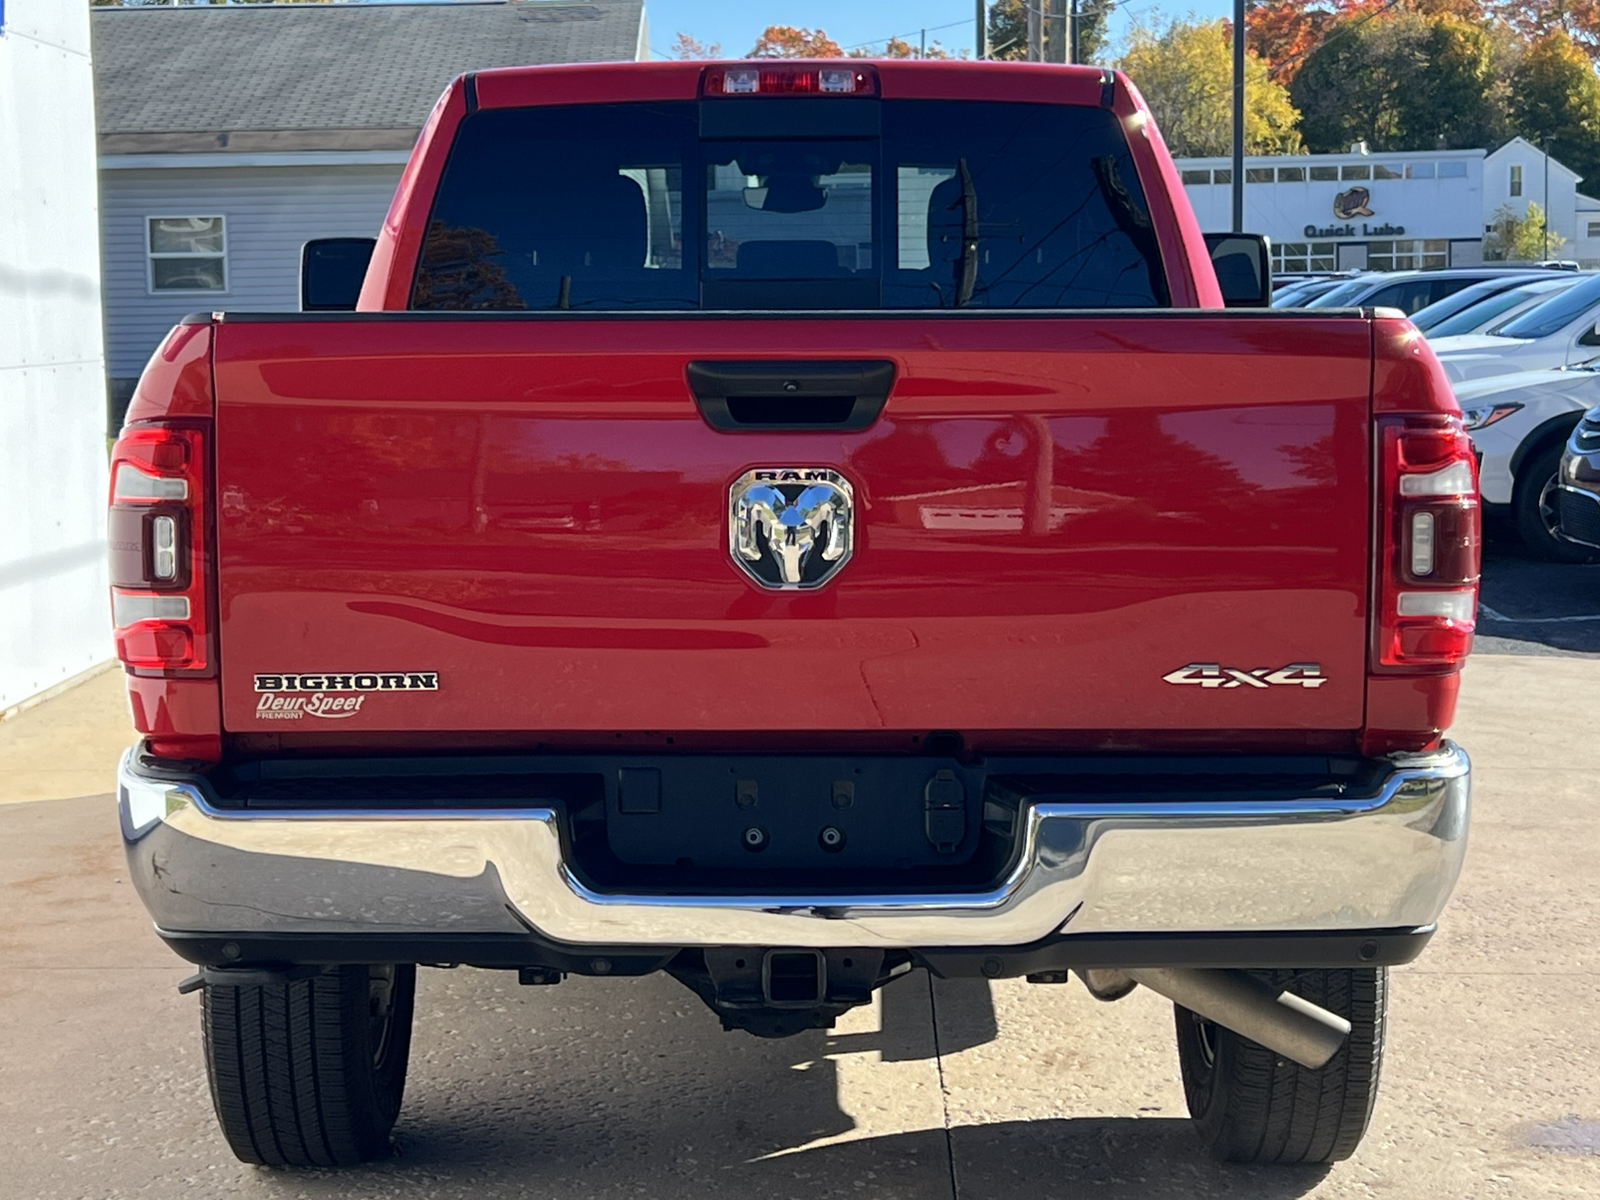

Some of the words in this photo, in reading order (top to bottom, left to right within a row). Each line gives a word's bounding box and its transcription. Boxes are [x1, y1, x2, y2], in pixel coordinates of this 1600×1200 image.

[1304, 224, 1356, 238] Quick
[1363, 223, 1405, 236] Lube
[755, 471, 828, 481] RAM
[254, 673, 438, 692] BIGHORN
[256, 710, 303, 719] FREMONT
